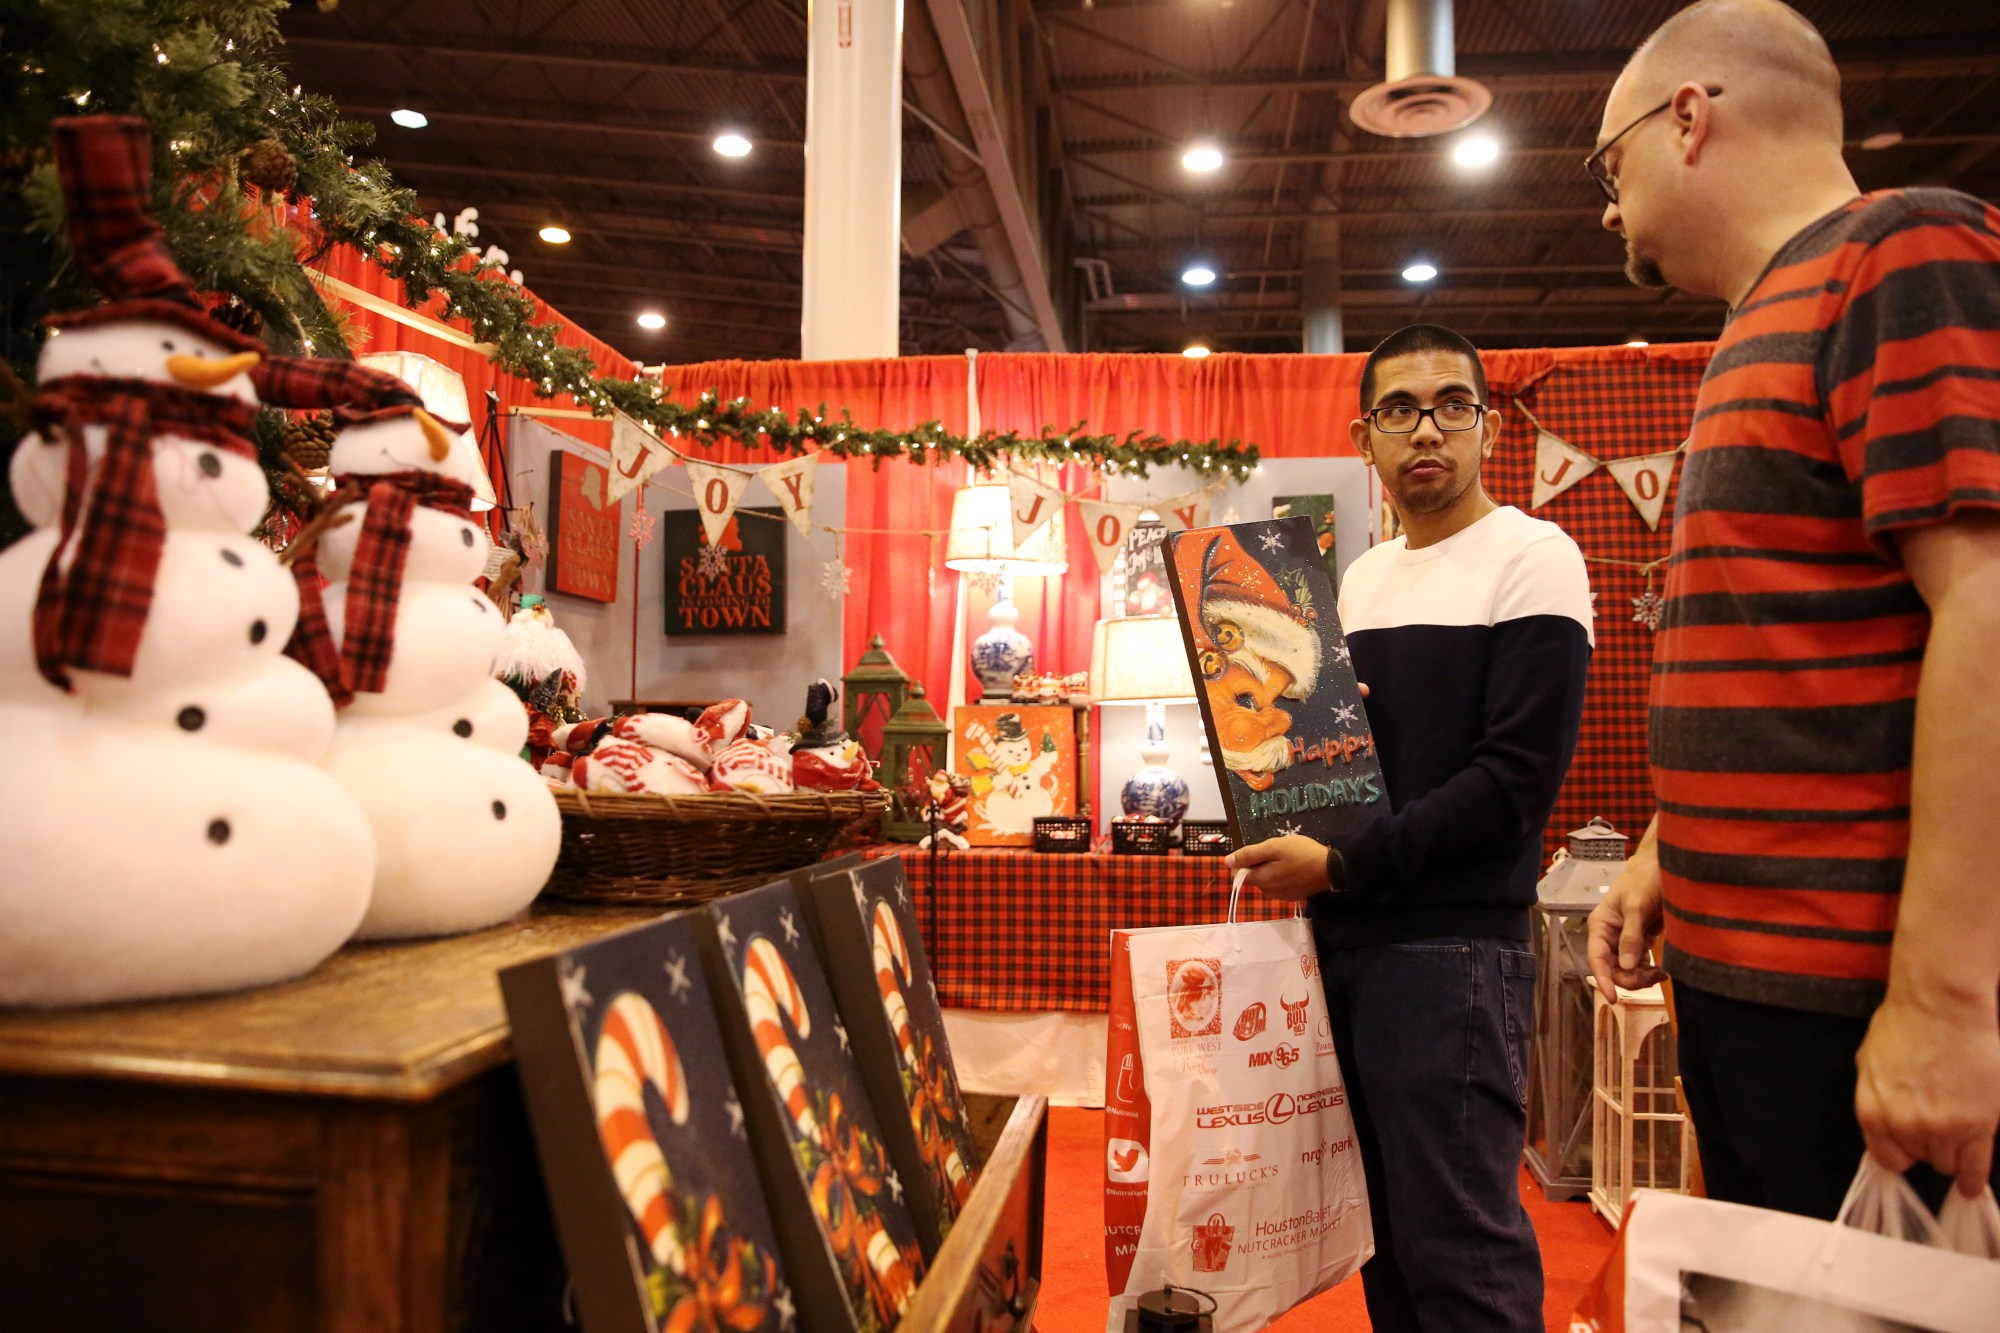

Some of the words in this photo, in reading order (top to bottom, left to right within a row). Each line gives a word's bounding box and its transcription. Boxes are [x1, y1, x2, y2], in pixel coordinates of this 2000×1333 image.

[616, 443, 806, 514] JOY
[680, 554, 771, 580] STA
[678, 574, 773, 597] CLAUS
[678, 605, 771, 628] TOWN
[1286, 732, 1375, 767] Happy
[1251, 772, 1382, 819] HOLIDAYS
[1286, 1008, 1308, 1031] BULL
[1197, 1041, 1223, 1052] WEST
[1248, 1051, 1274, 1068] MIX
[1296, 1085, 1344, 1102] NORTHSIDE
[1296, 1094, 1344, 1115] LEXUS
[1196, 1101, 1265, 1116] WESTSIDE
[1196, 1112, 1265, 1129] LEXUS
[1301, 1149, 1321, 1166] nrg
[1330, 1136, 1354, 1158] park
[1182, 1165, 1280, 1187] TRULUCK'S
[1237, 1229, 1308, 1255] NUTCRACKER
